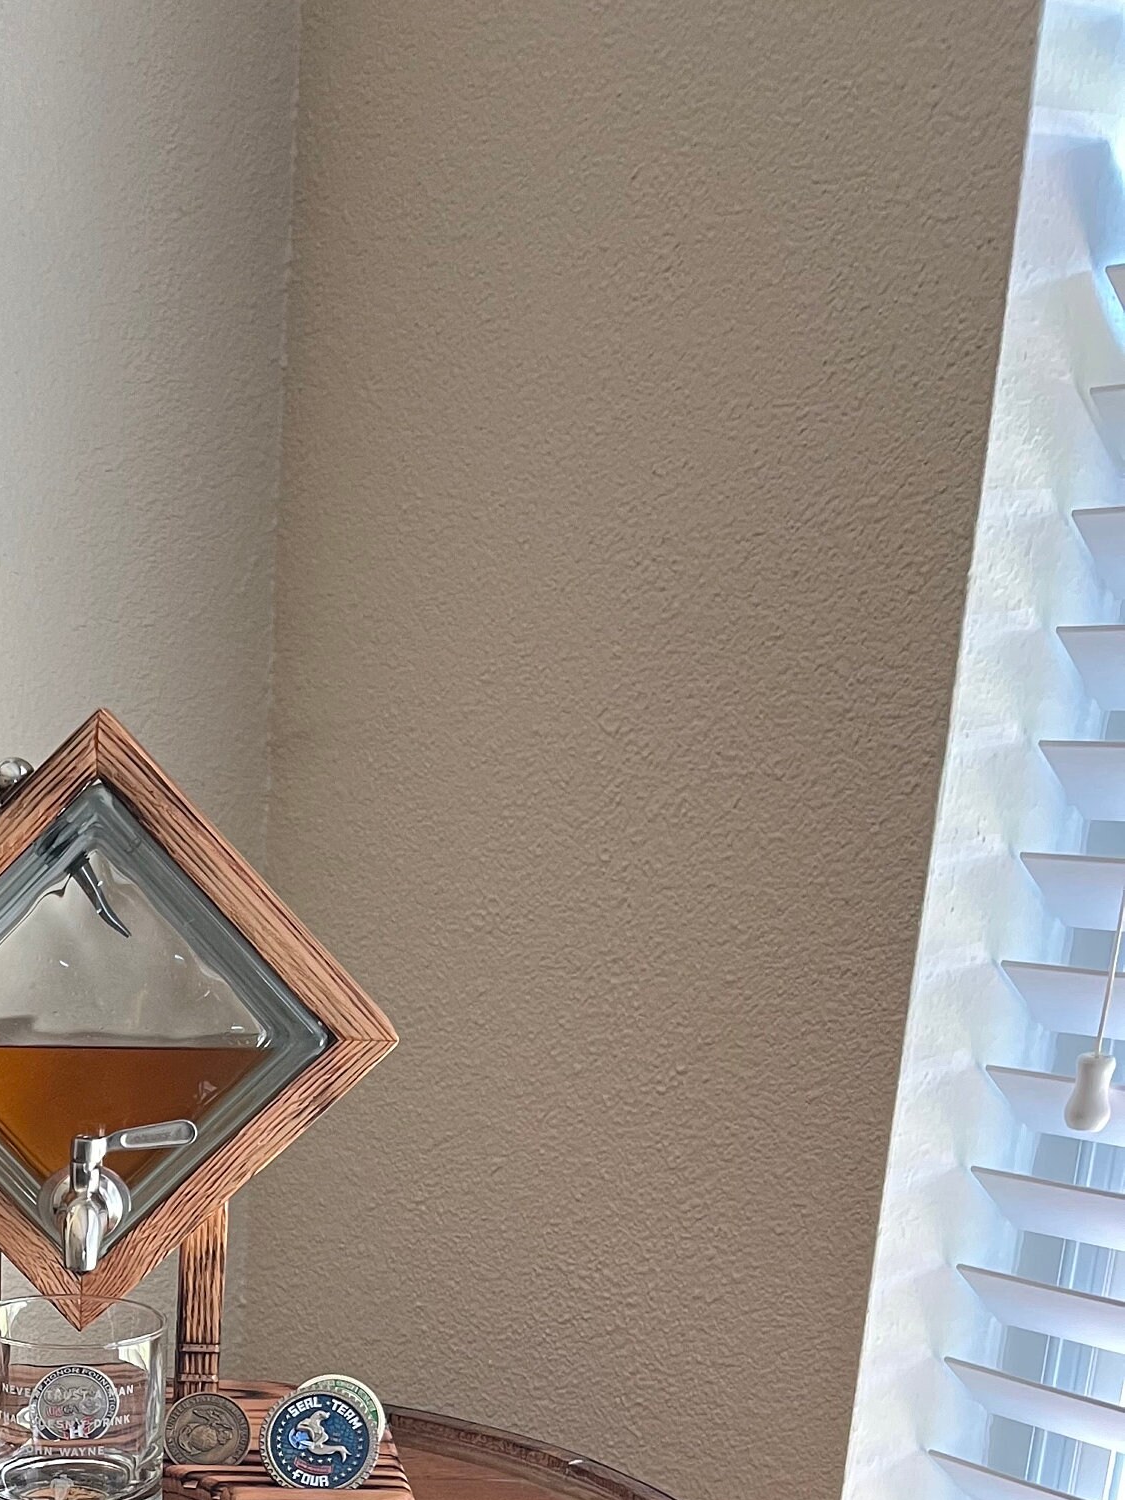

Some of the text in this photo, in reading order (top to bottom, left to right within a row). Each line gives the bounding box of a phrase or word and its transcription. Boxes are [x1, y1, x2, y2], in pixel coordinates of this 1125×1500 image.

[44, 1367, 81, 1385] HONOR
[2, 1382, 32, 1398] NEVE
[93, 1414, 131, 1428] DRINK
[287, 1396, 323, 1418] SEAL
[330, 1398, 364, 1430] TEAM
[59, 1445, 105, 1457] WAYNE
[292, 1469, 330, 1487] FOUR
